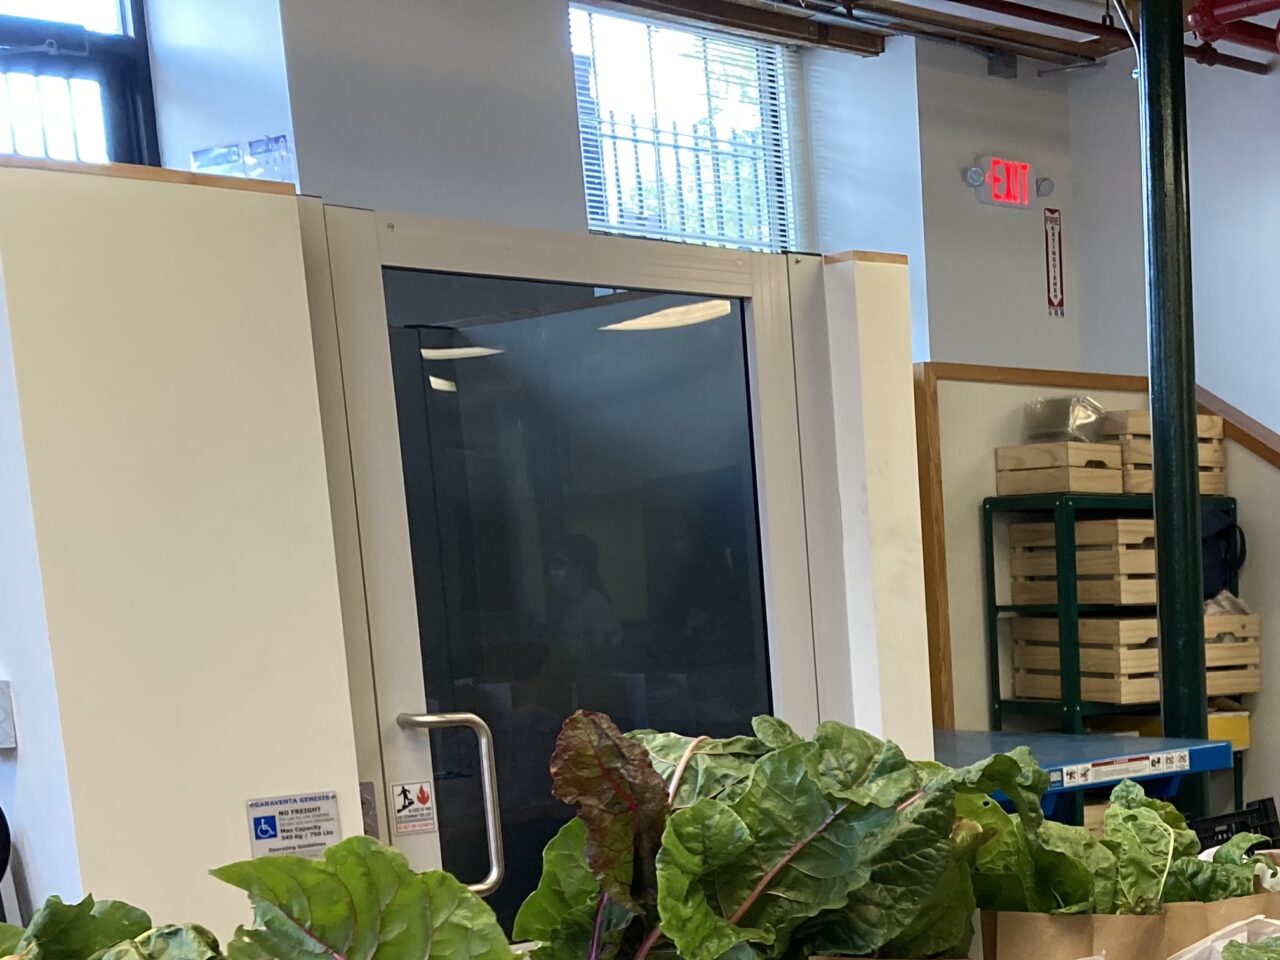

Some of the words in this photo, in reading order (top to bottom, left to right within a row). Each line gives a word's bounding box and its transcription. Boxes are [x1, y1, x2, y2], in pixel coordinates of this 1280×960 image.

[991, 157, 1030, 205] EXIT
[1045, 216, 1060, 225] FIRE
[255, 798, 298, 807] GARAVENTA
[299, 795, 330, 803] GENESIS
[291, 807, 321, 815] FREIGHT
